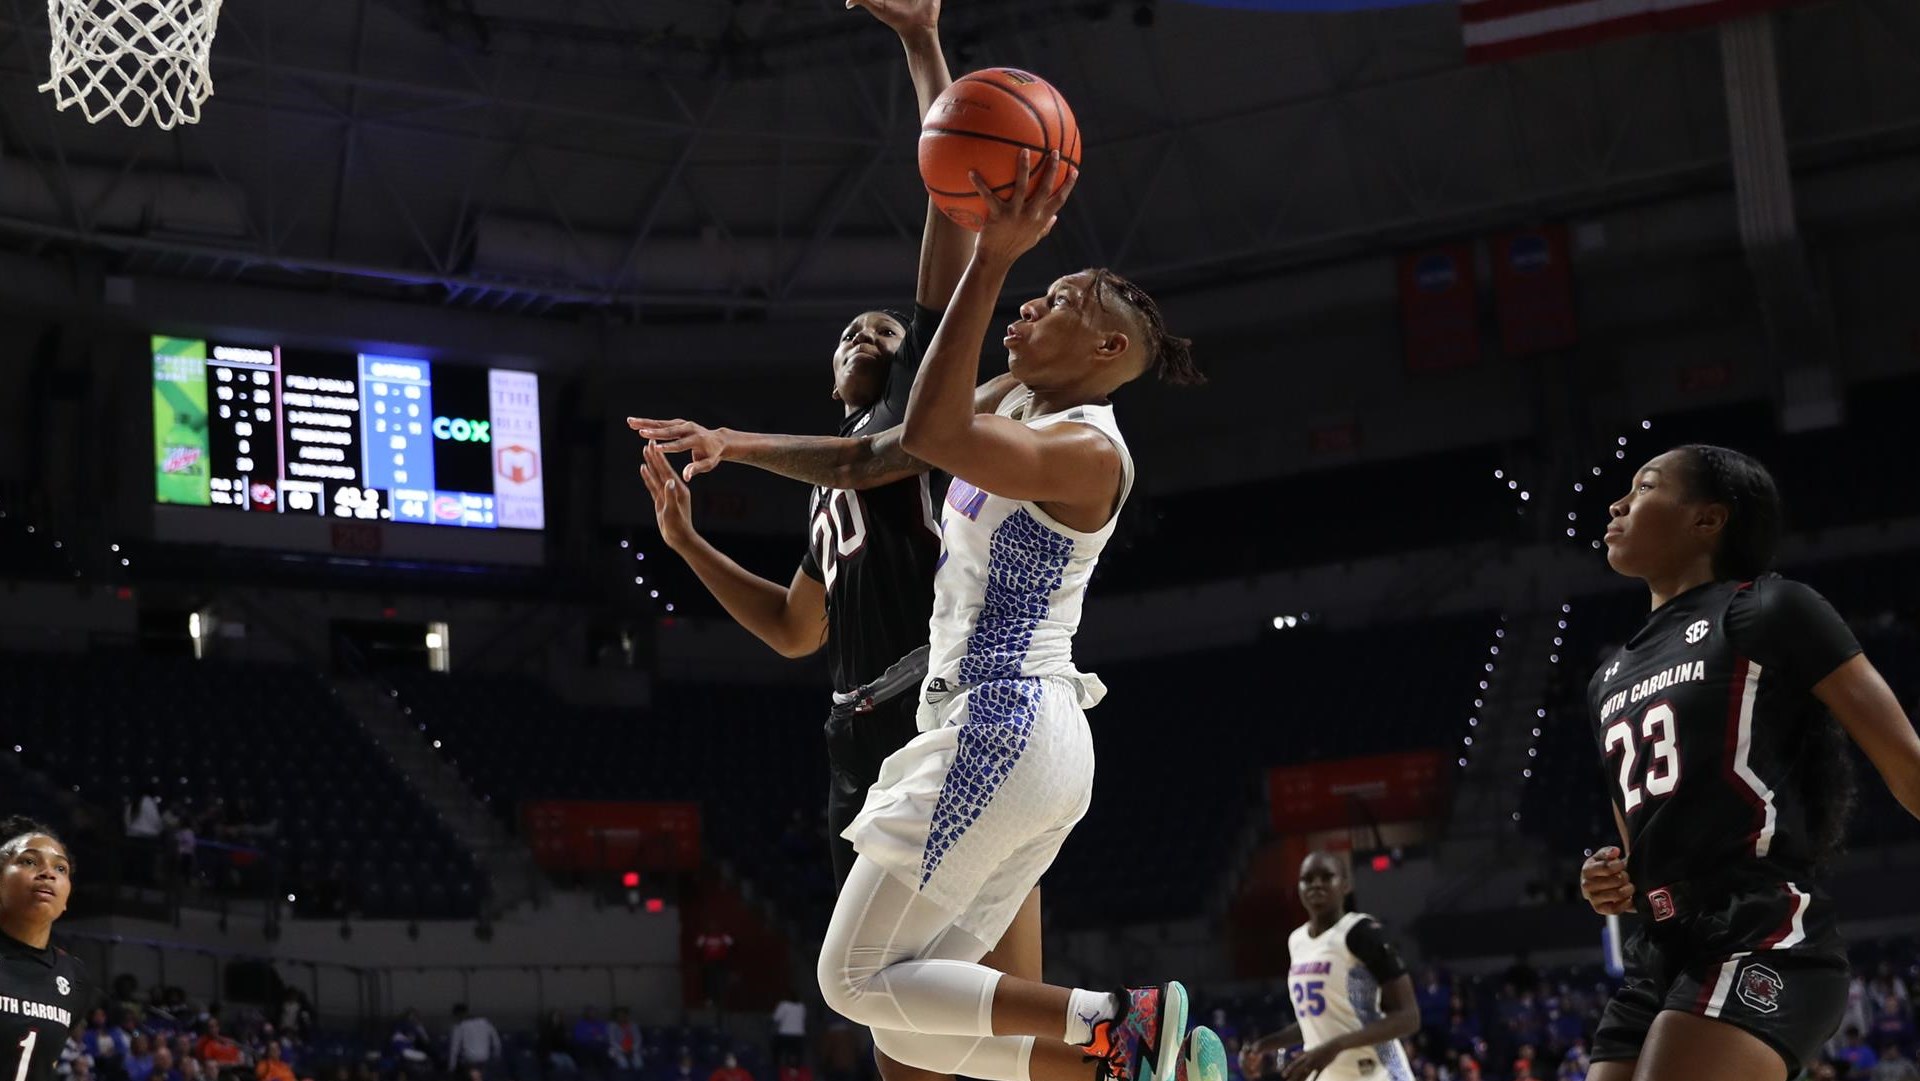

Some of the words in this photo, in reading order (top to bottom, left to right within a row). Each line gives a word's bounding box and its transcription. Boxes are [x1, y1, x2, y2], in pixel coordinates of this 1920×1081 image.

[433, 416, 490, 443] COX
[812, 488, 866, 592] 20
[1685, 619, 1709, 644] SEC
[930, 680, 941, 690] 42
[1631, 660, 1705, 703] CAROLINA
[1603, 702, 1681, 813] 23
[1293, 981, 1327, 1018] 25
[15, 1031, 37, 1081] 1
